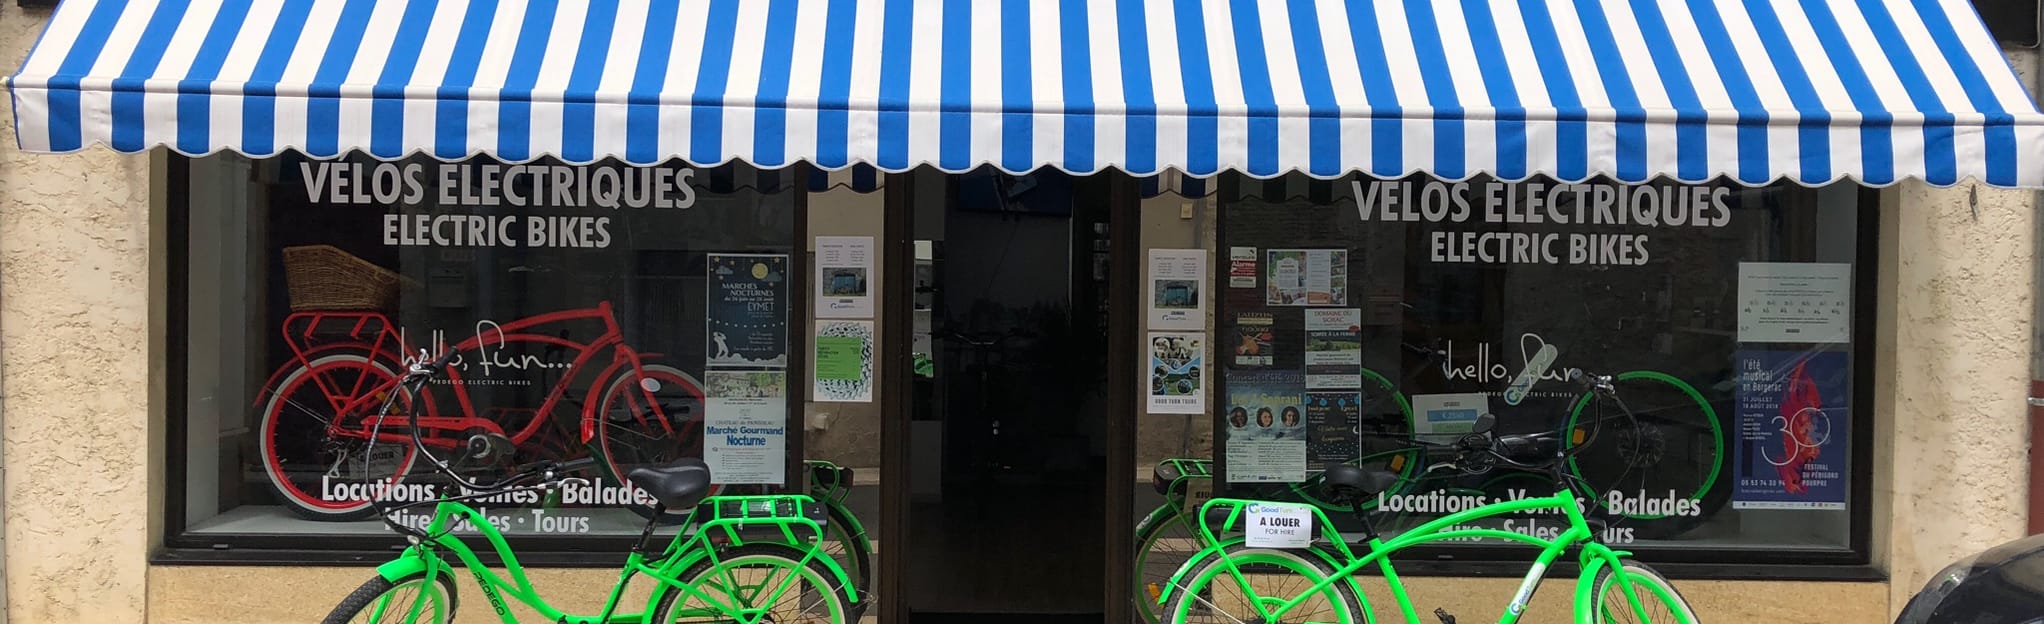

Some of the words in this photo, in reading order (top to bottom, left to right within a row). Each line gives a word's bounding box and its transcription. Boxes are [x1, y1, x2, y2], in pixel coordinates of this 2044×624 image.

[383, 214, 517, 247] ELECTRIC
[527, 216, 611, 249] BIKES
[1431, 231, 1559, 265] ELECTRIC
[1569, 233, 1649, 266] BIKES
[1743, 369, 1773, 381] musical
[706, 425, 738, 435] Marché
[740, 426, 784, 436] Gourmand
[727, 435, 767, 446] Nocturne
[1804, 463, 1828, 471] FESTIVAL
[322, 475, 435, 502] Locations
[1378, 489, 1487, 513] Locations
[1608, 489, 1701, 516] Balades
[532, 508, 590, 533] Tours
[1260, 517, 1267, 526] A
[1270, 517, 1300, 528] LOUER
[1503, 518, 1559, 544] Sales
[473, 571, 506, 616] PEDEGO
